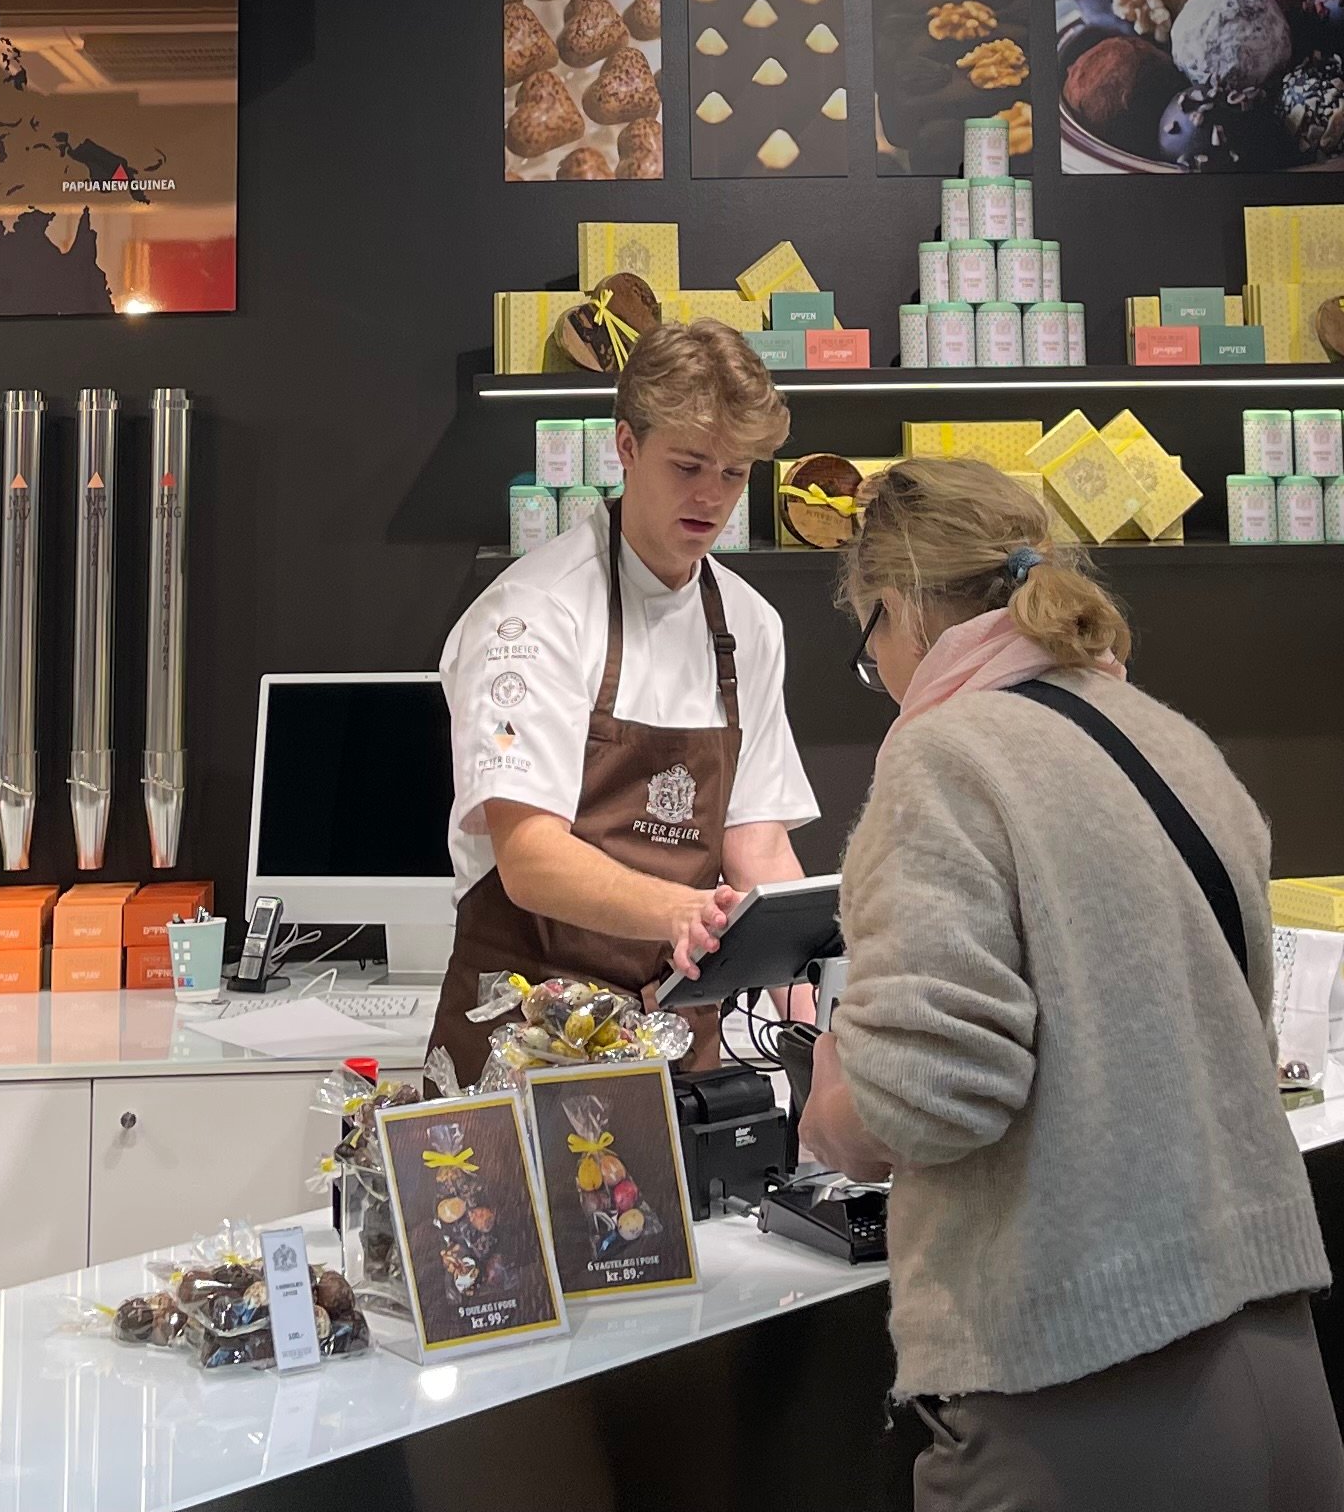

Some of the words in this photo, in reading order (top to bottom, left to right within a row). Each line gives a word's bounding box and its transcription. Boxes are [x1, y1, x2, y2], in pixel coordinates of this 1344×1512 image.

[62, 181, 100, 192] PAPUA
[102, 180, 129, 191] NEW
[131, 179, 176, 190] GUINEA
[633, 820, 666, 835] PETER
[668, 827, 700, 840] BEIER
[587, 1261, 594, 1271] 6
[606, 1270, 623, 1283] kr.
[623, 1268, 645, 1281] 89.-
[487, 1312, 510, 1326] 99.-
